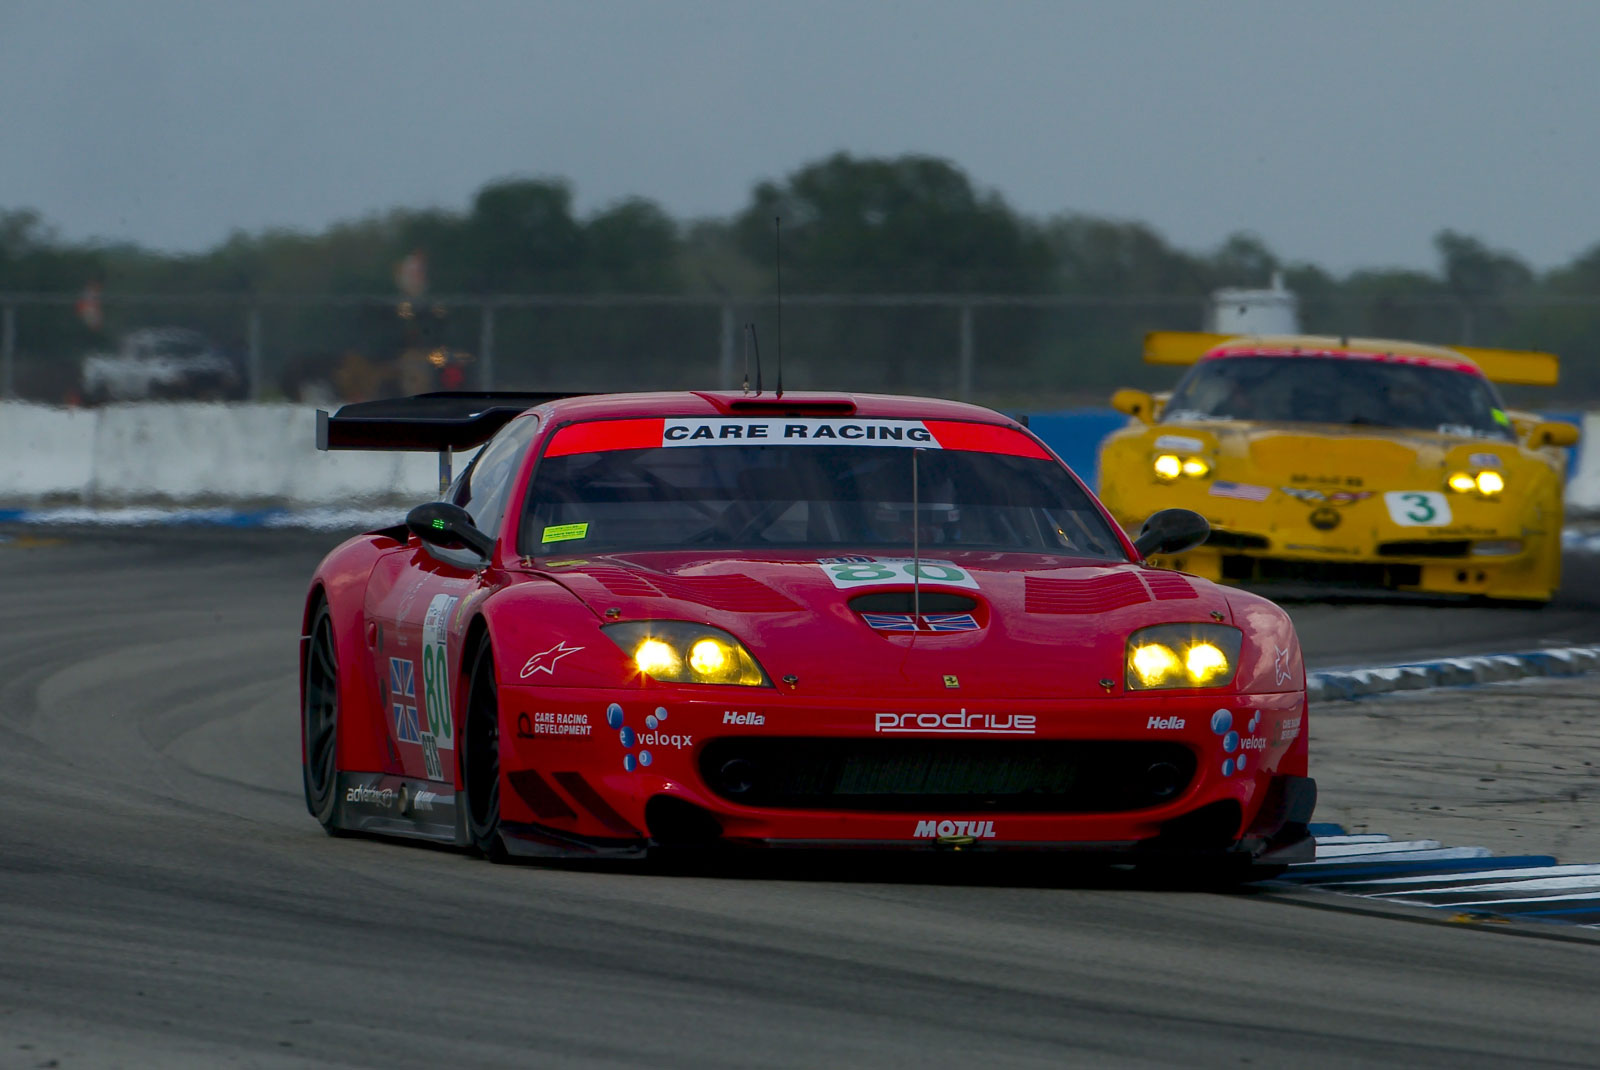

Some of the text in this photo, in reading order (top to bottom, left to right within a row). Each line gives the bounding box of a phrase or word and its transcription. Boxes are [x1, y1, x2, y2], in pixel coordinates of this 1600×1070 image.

[663, 424, 932, 442] CARE RACING
[1401, 492, 1437, 523] 3
[830, 563, 966, 582] 80
[424, 644, 451, 739] 80
[534, 712, 588, 725] CARE RACING
[722, 711, 766, 726] Hella
[874, 708, 1037, 733] prodrive
[1146, 715, 1186, 730] Hella
[534, 723, 593, 735] DEVELOPMENT
[637, 730, 693, 750] veloqx
[1240, 734, 1267, 752] veloqx
[913, 819, 997, 838] MOTUL
